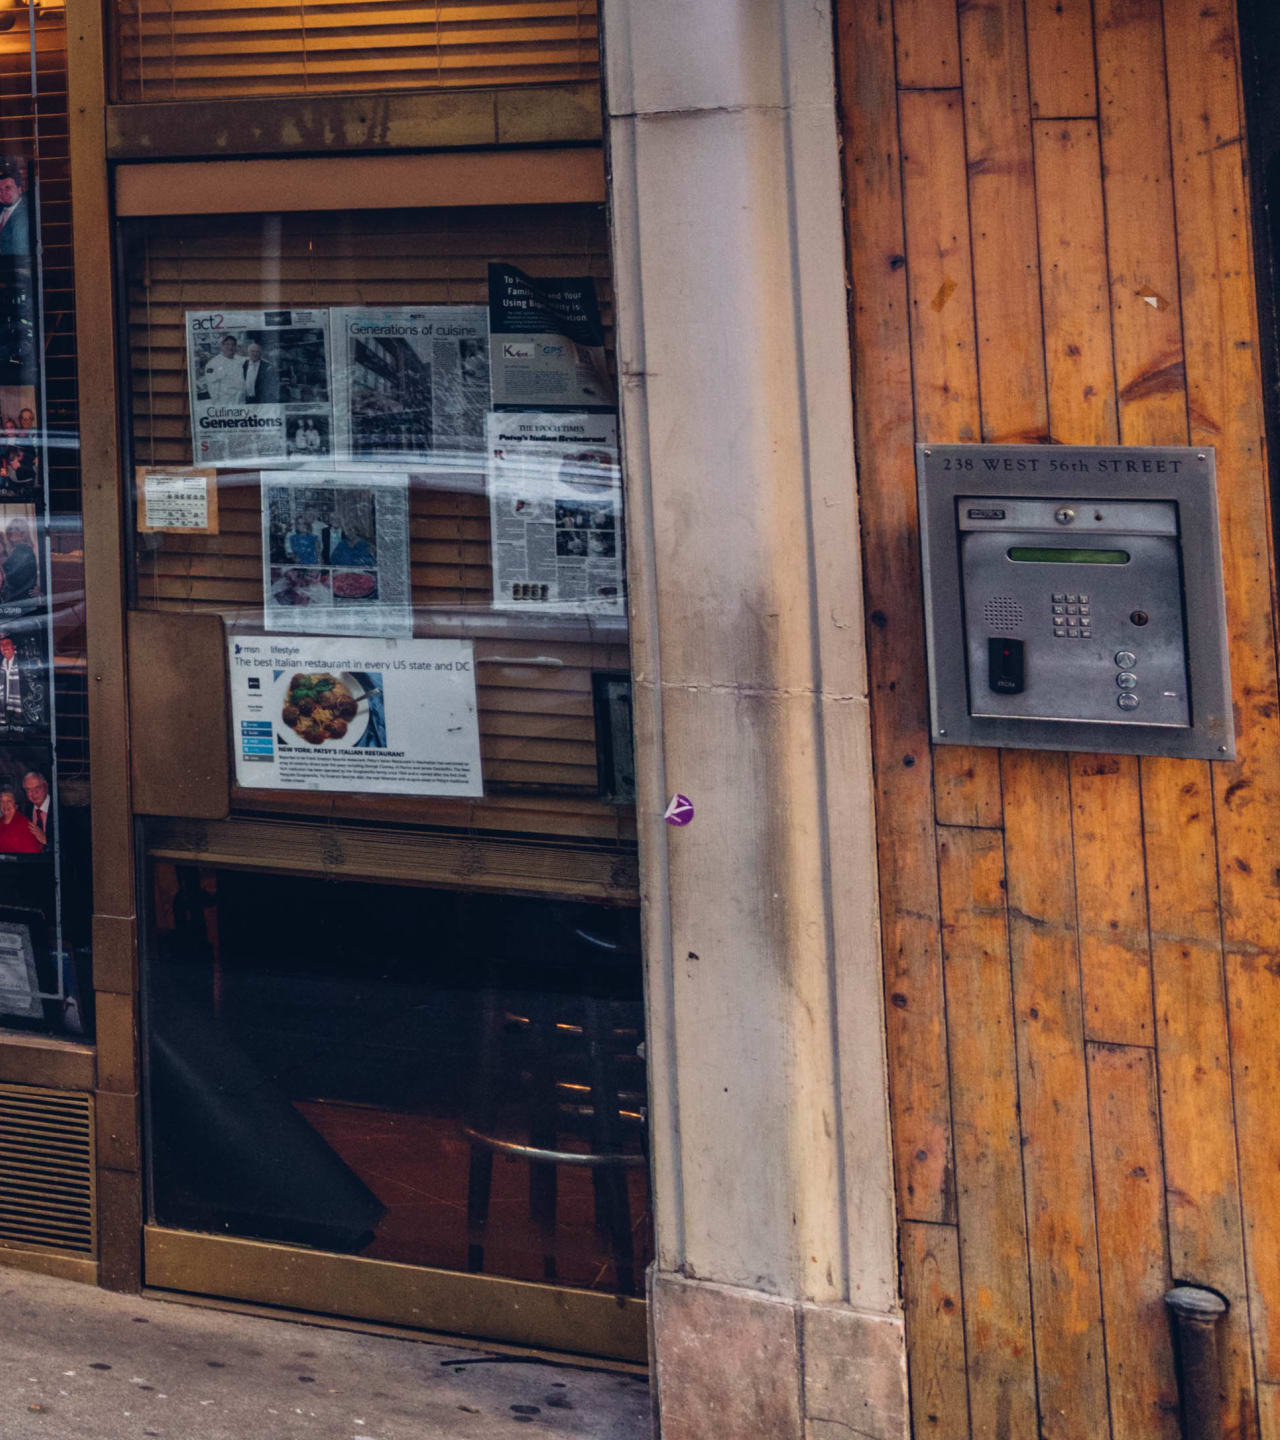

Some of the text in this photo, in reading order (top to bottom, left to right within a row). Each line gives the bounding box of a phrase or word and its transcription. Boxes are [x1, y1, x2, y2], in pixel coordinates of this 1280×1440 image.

[192, 314, 224, 330] act2
[350, 322, 476, 337] Generations of cuisine
[207, 407, 250, 420] Culinary
[199, 415, 283, 429] Generations
[943, 459, 1183, 473] 238 WEST 56th STREET
[270, 646, 300, 655] lifestyle
[234, 658, 470, 672] The best Italian restaurant in every US state and DC
